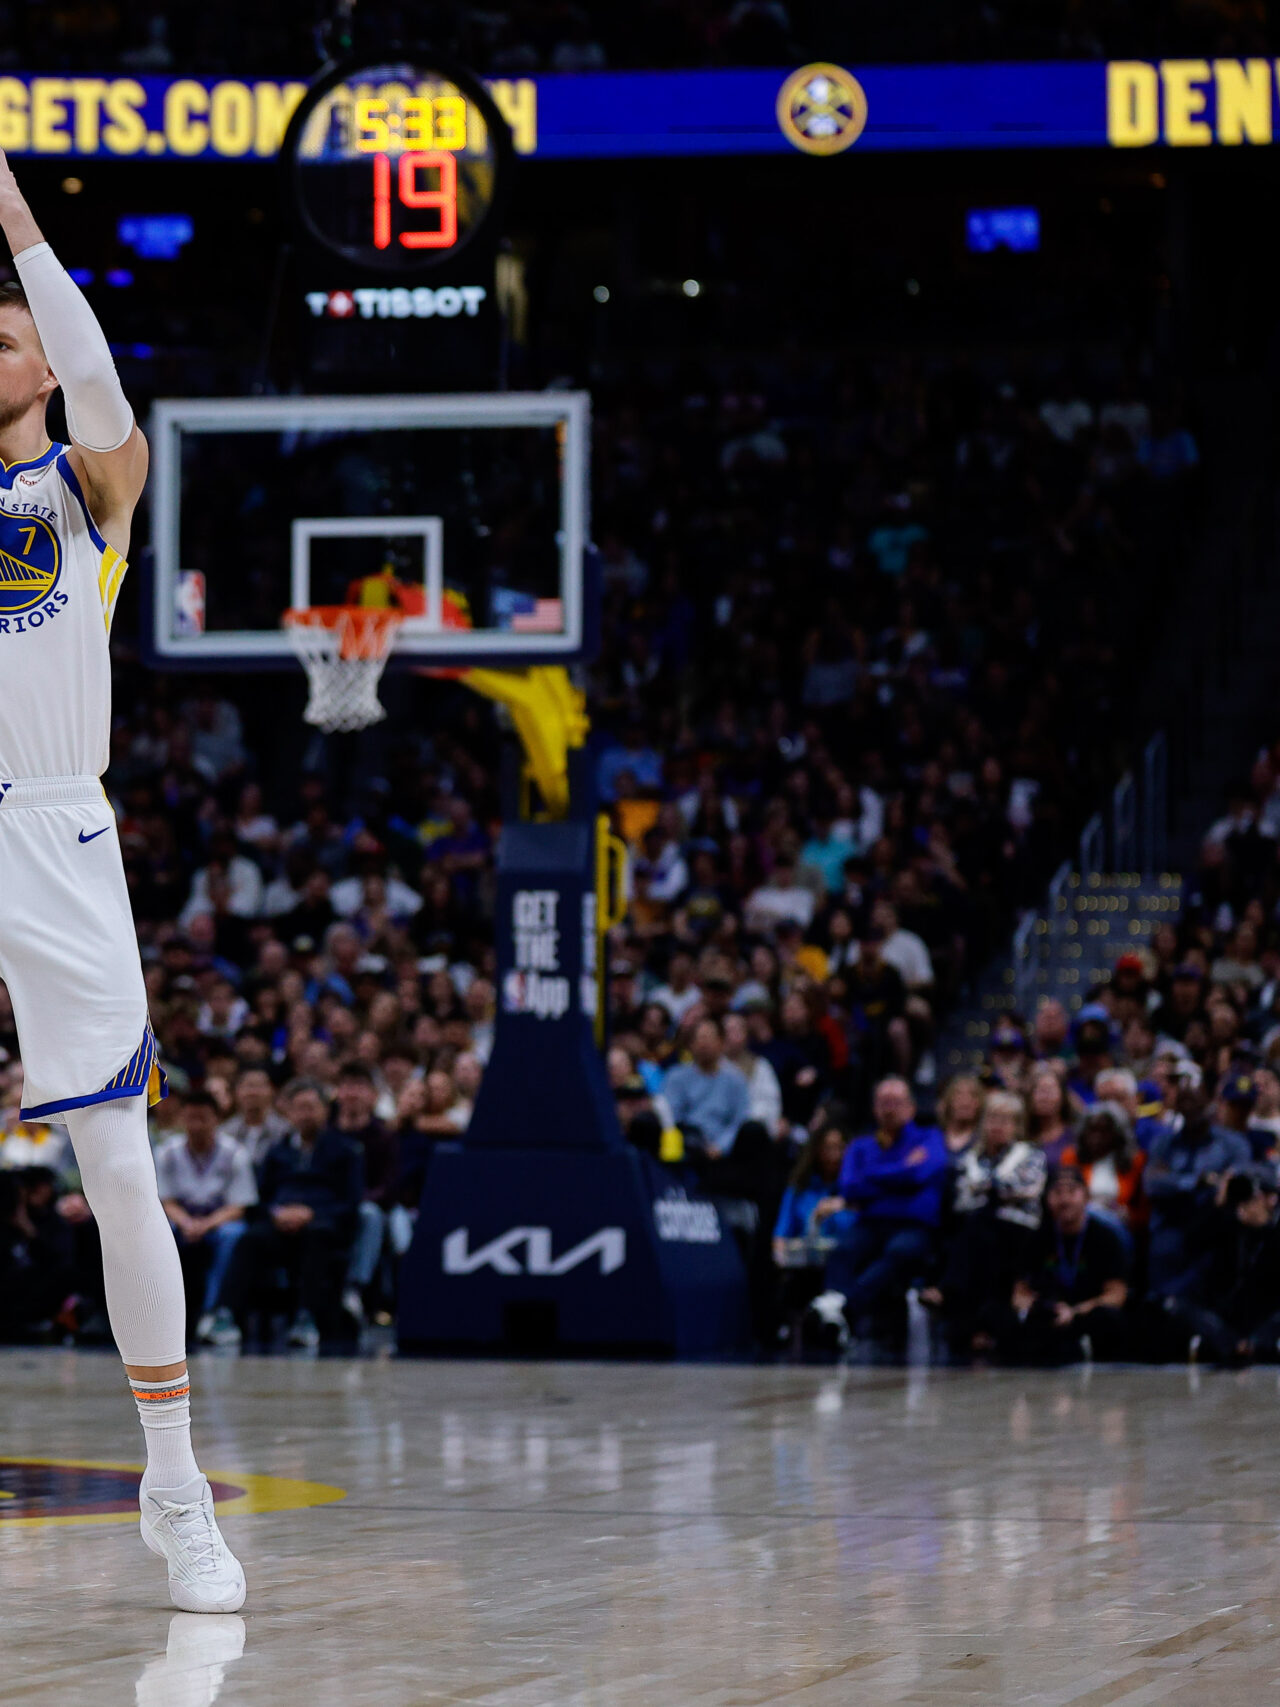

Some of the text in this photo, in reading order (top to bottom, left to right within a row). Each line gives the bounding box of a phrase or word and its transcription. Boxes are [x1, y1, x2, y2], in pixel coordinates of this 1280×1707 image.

[356, 97, 466, 152] 5:33
[1107, 57, 1280, 148] DEN
[373, 151, 458, 249] 19
[353, 286, 486, 319] TISSOT
[11, 503, 58, 522] STATE
[18, 526, 37, 556] 7
